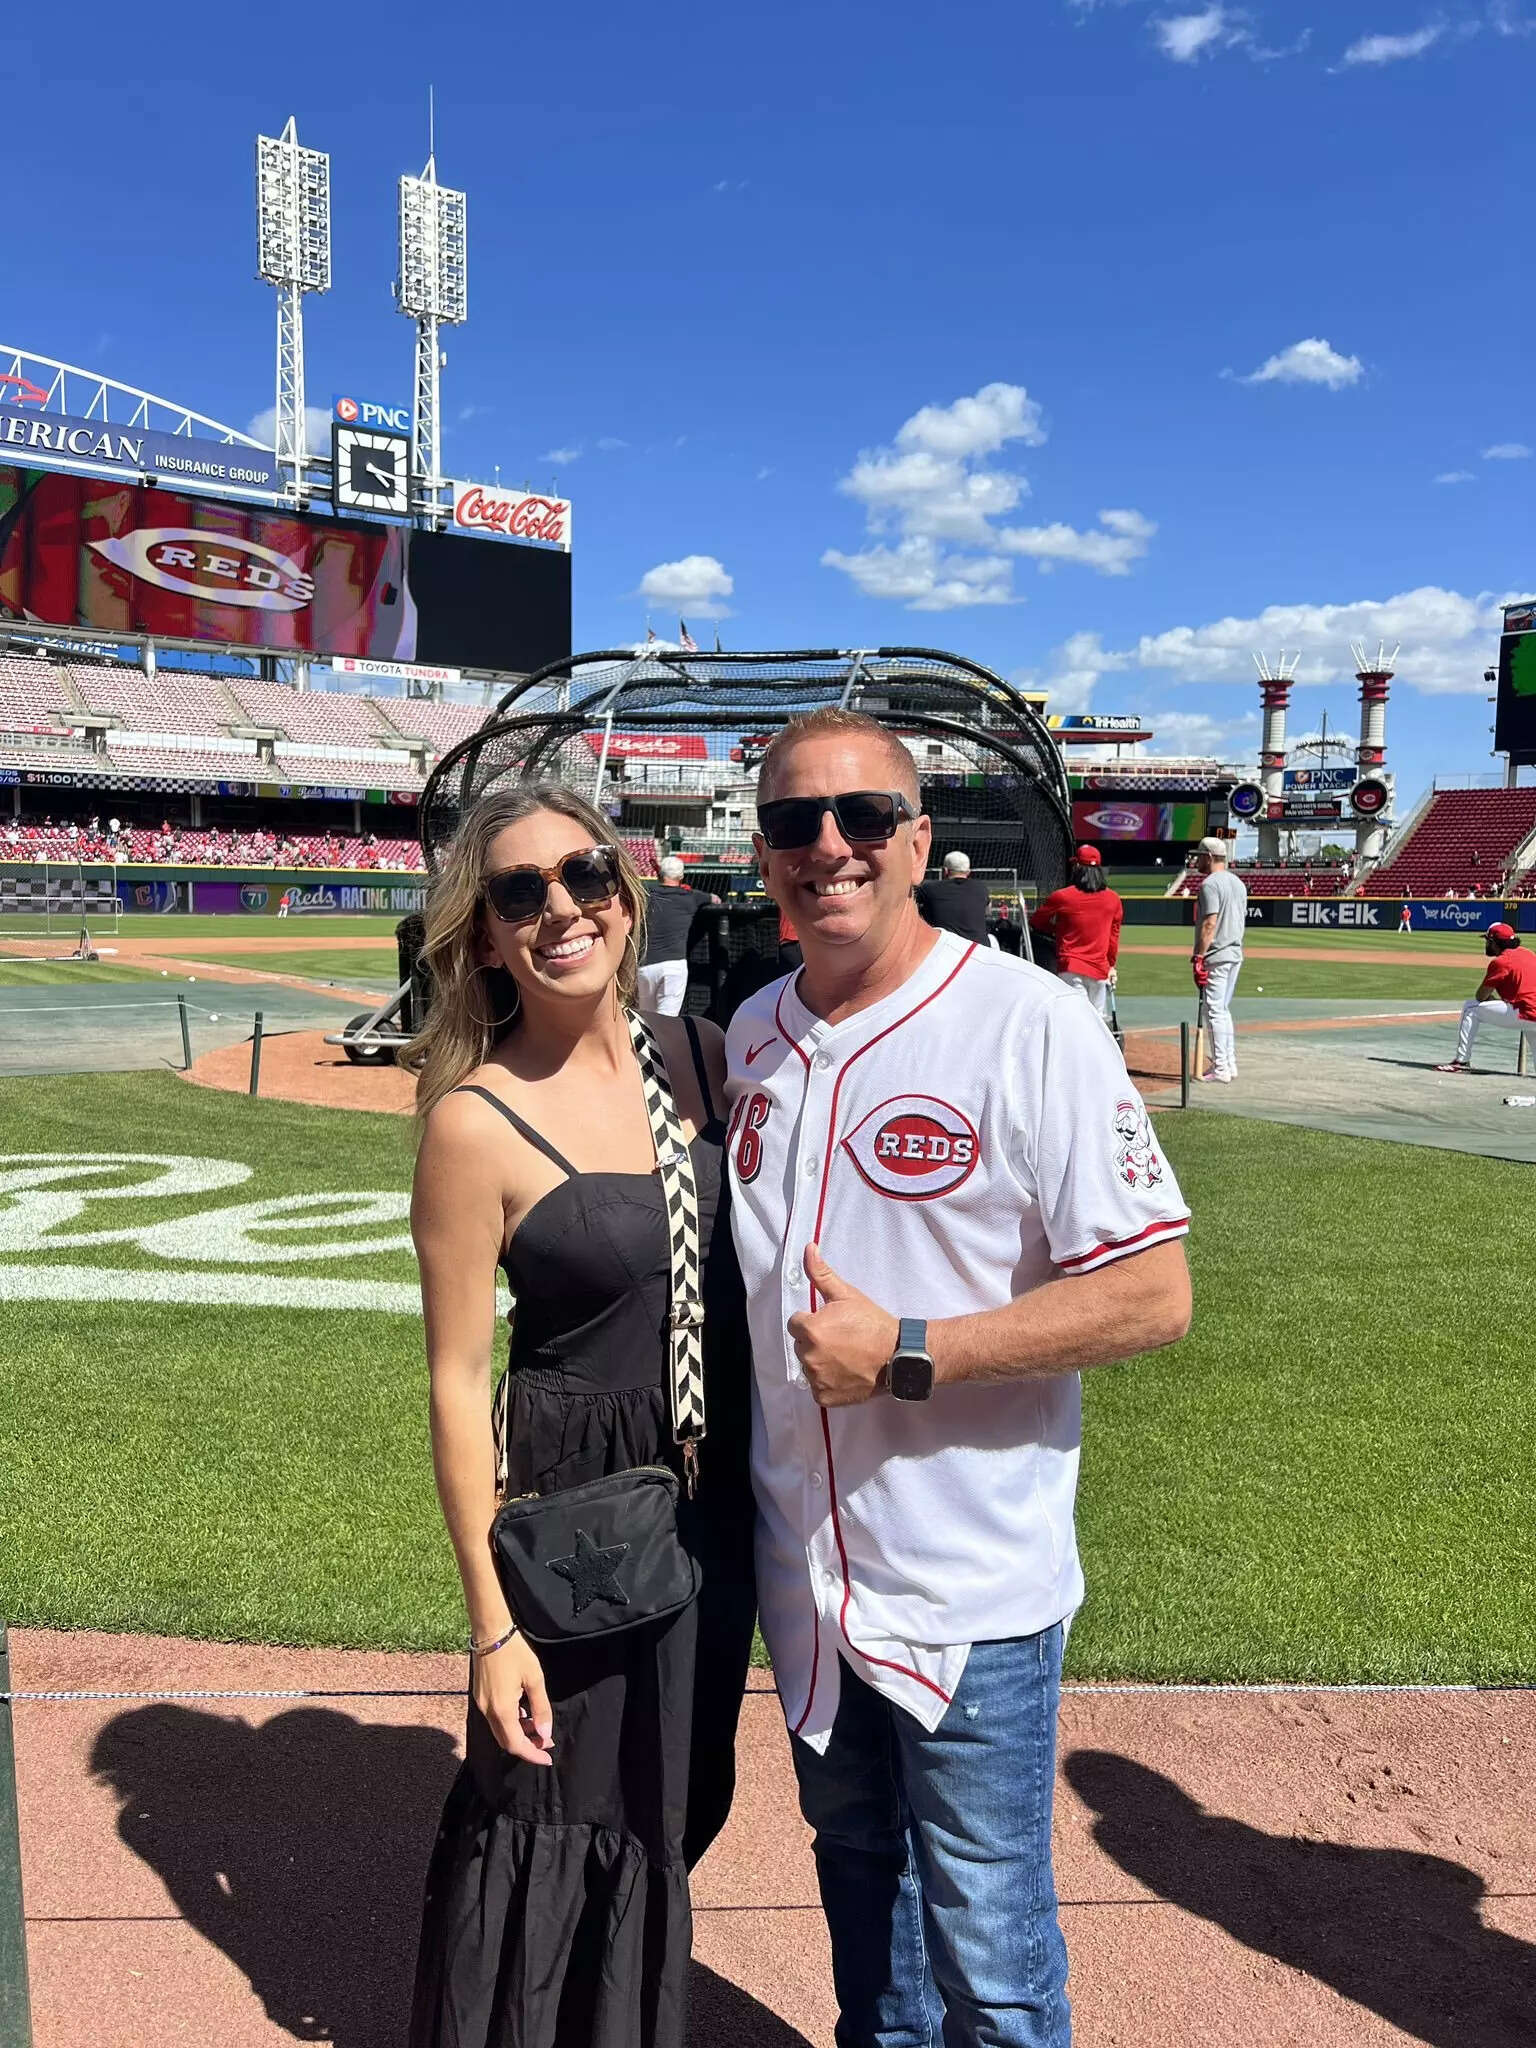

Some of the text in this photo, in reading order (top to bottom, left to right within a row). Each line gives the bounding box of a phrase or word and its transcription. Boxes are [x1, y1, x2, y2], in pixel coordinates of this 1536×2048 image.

[360, 402, 409, 430] PNC
[154, 454, 226, 478] INSURANCE
[228, 468, 270, 485] GROUP
[455, 487, 569, 541] Coca-Cola
[155, 545, 315, 600] REDS
[360, 662, 449, 680] TOYOTA TUNDRA
[1093, 716, 1140, 729] TriHealth
[26, 773, 72, 784] $11,100
[1310, 769, 1344, 782] PNC
[1319, 781, 1352, 789] STACKS
[247, 893, 263, 905] 71
[284, 885, 428, 913] Reds RACING NIGHT
[1440, 904, 1482, 927] Kroger
[877, 1132, 974, 1165] REDS
